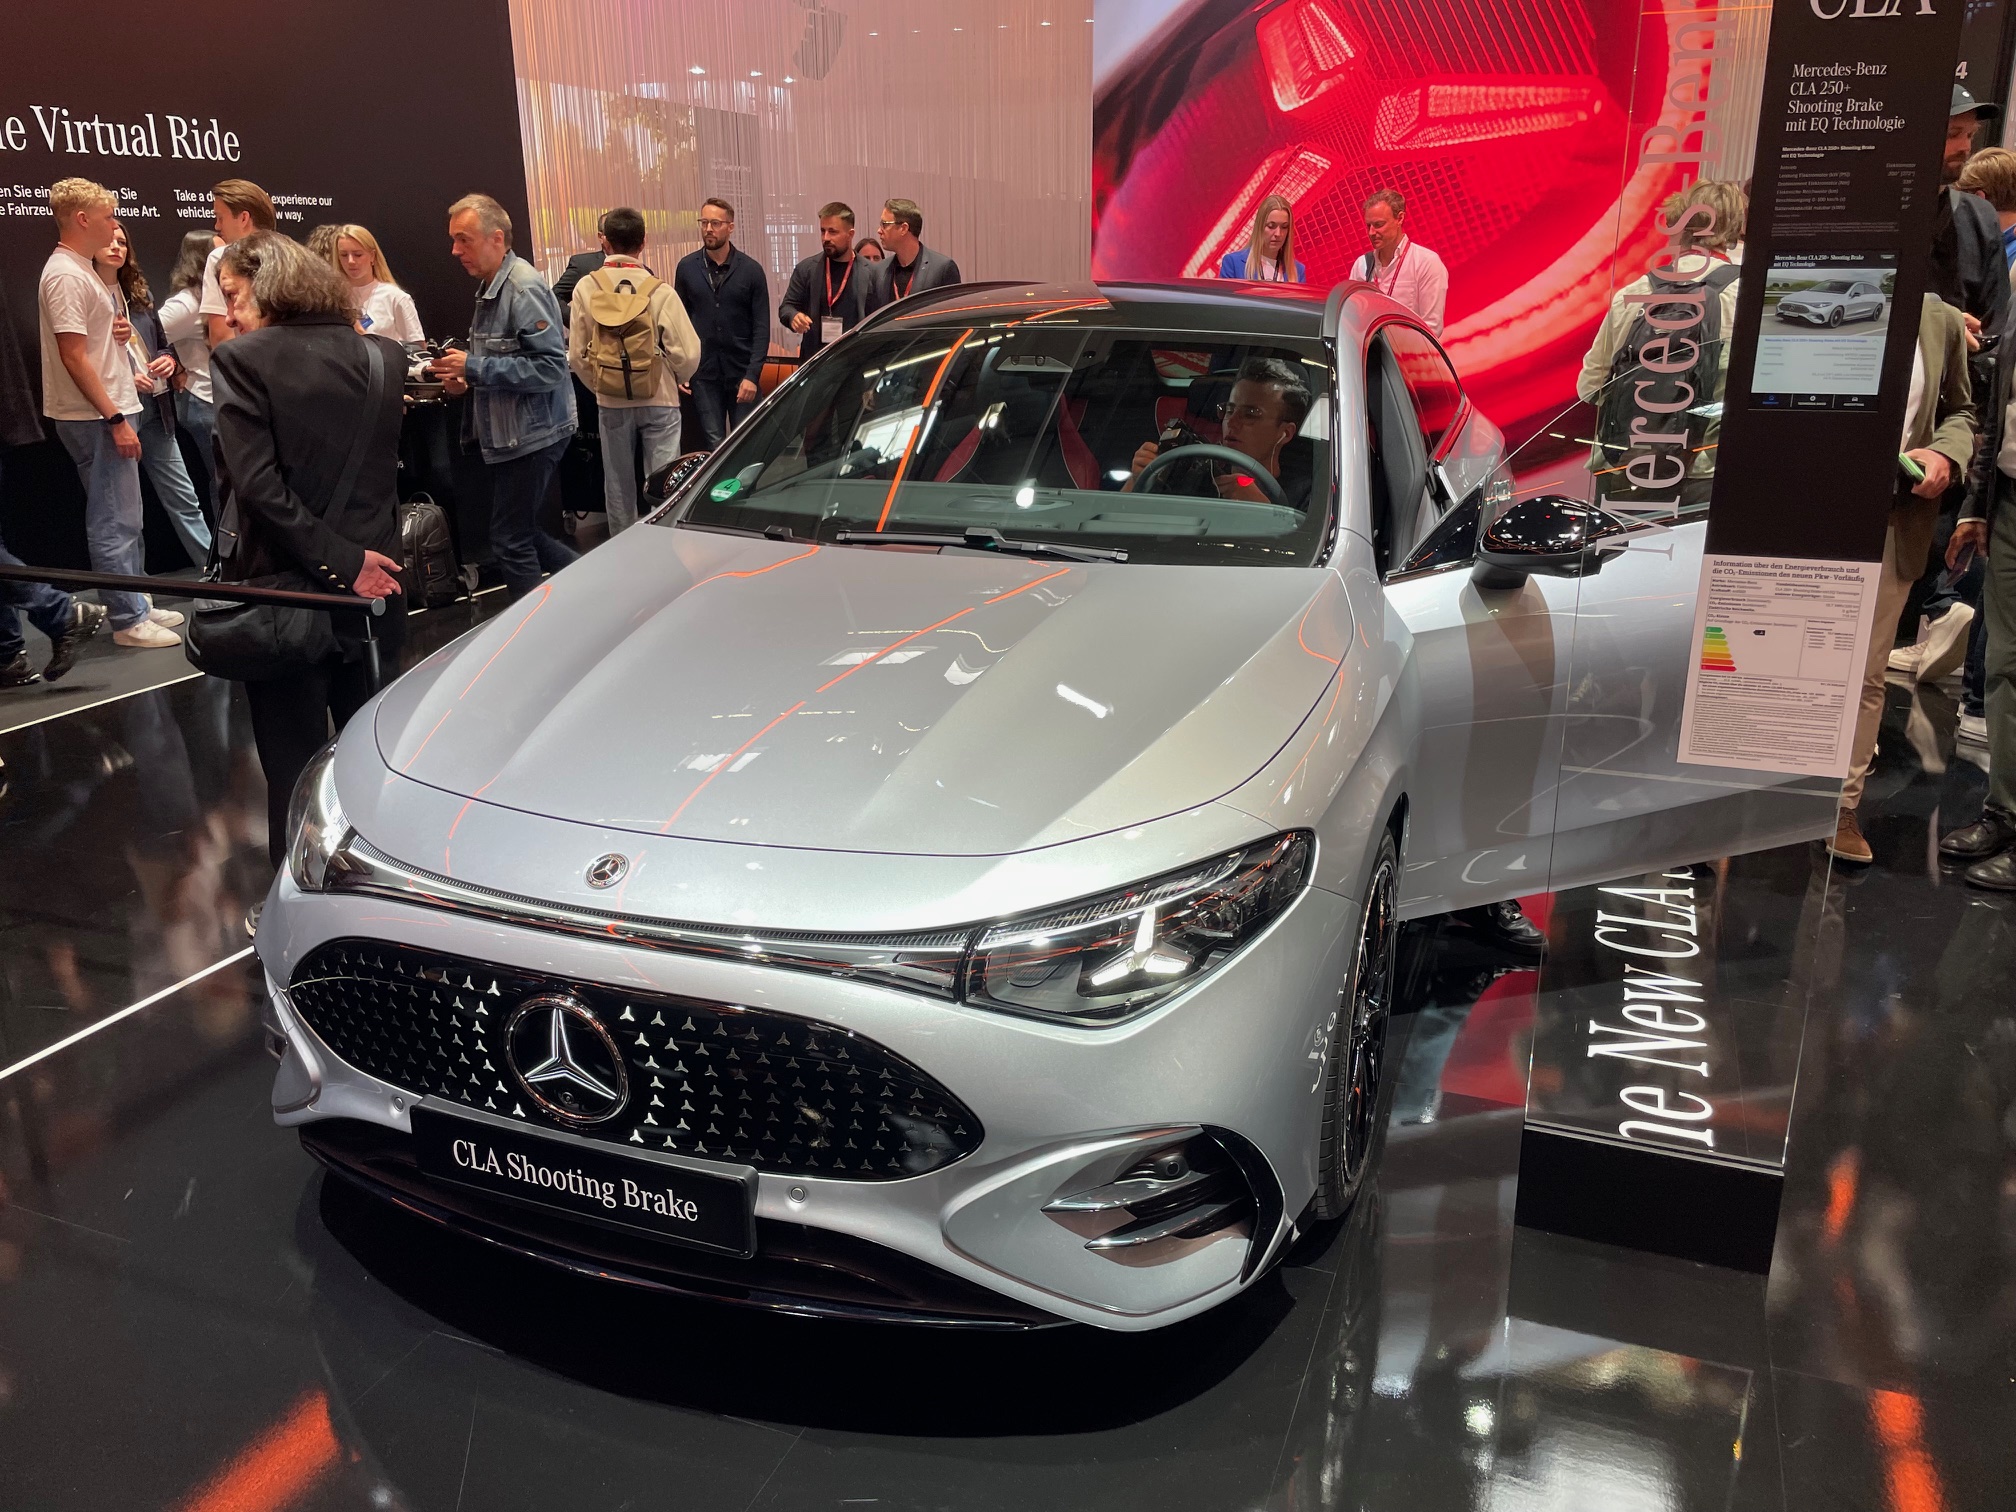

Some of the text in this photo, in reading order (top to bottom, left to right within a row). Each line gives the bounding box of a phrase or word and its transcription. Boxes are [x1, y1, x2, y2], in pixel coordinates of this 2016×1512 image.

[1792, 61, 1888, 78] Mercedes-Benz
[1790, 80, 1852, 96] CLA 250+
[1787, 98, 1884, 115] Shooting Brake
[1785, 115, 1905, 134] mit EQ Technologie
[30, 105, 162, 158] Virtual
[165, 115, 241, 162] Ride
[13, 184, 32, 198] Sie
[120, 187, 138, 200] Sie
[173, 189, 197, 202] Take
[199, 193, 205, 201] a
[271, 194, 333, 207] experience our
[114, 205, 161, 218] neue Art.
[177, 206, 216, 219] vehicles
[284, 211, 304, 222] way.
[1594, 0, 1741, 561] Mercedes-Ben
[1713, 560, 1752, 569] Information
[1754, 561, 1769, 569] über
[1770, 562, 1783, 570] den
[1784, 564, 1844, 573] Energieverbrauch
[1834, 574, 1865, 583] Vorläufig
[1594, 887, 1700, 958] CLA
[1587, 963, 1709, 1077] New
[453, 1139, 698, 1222] CLA Shooting Brake
